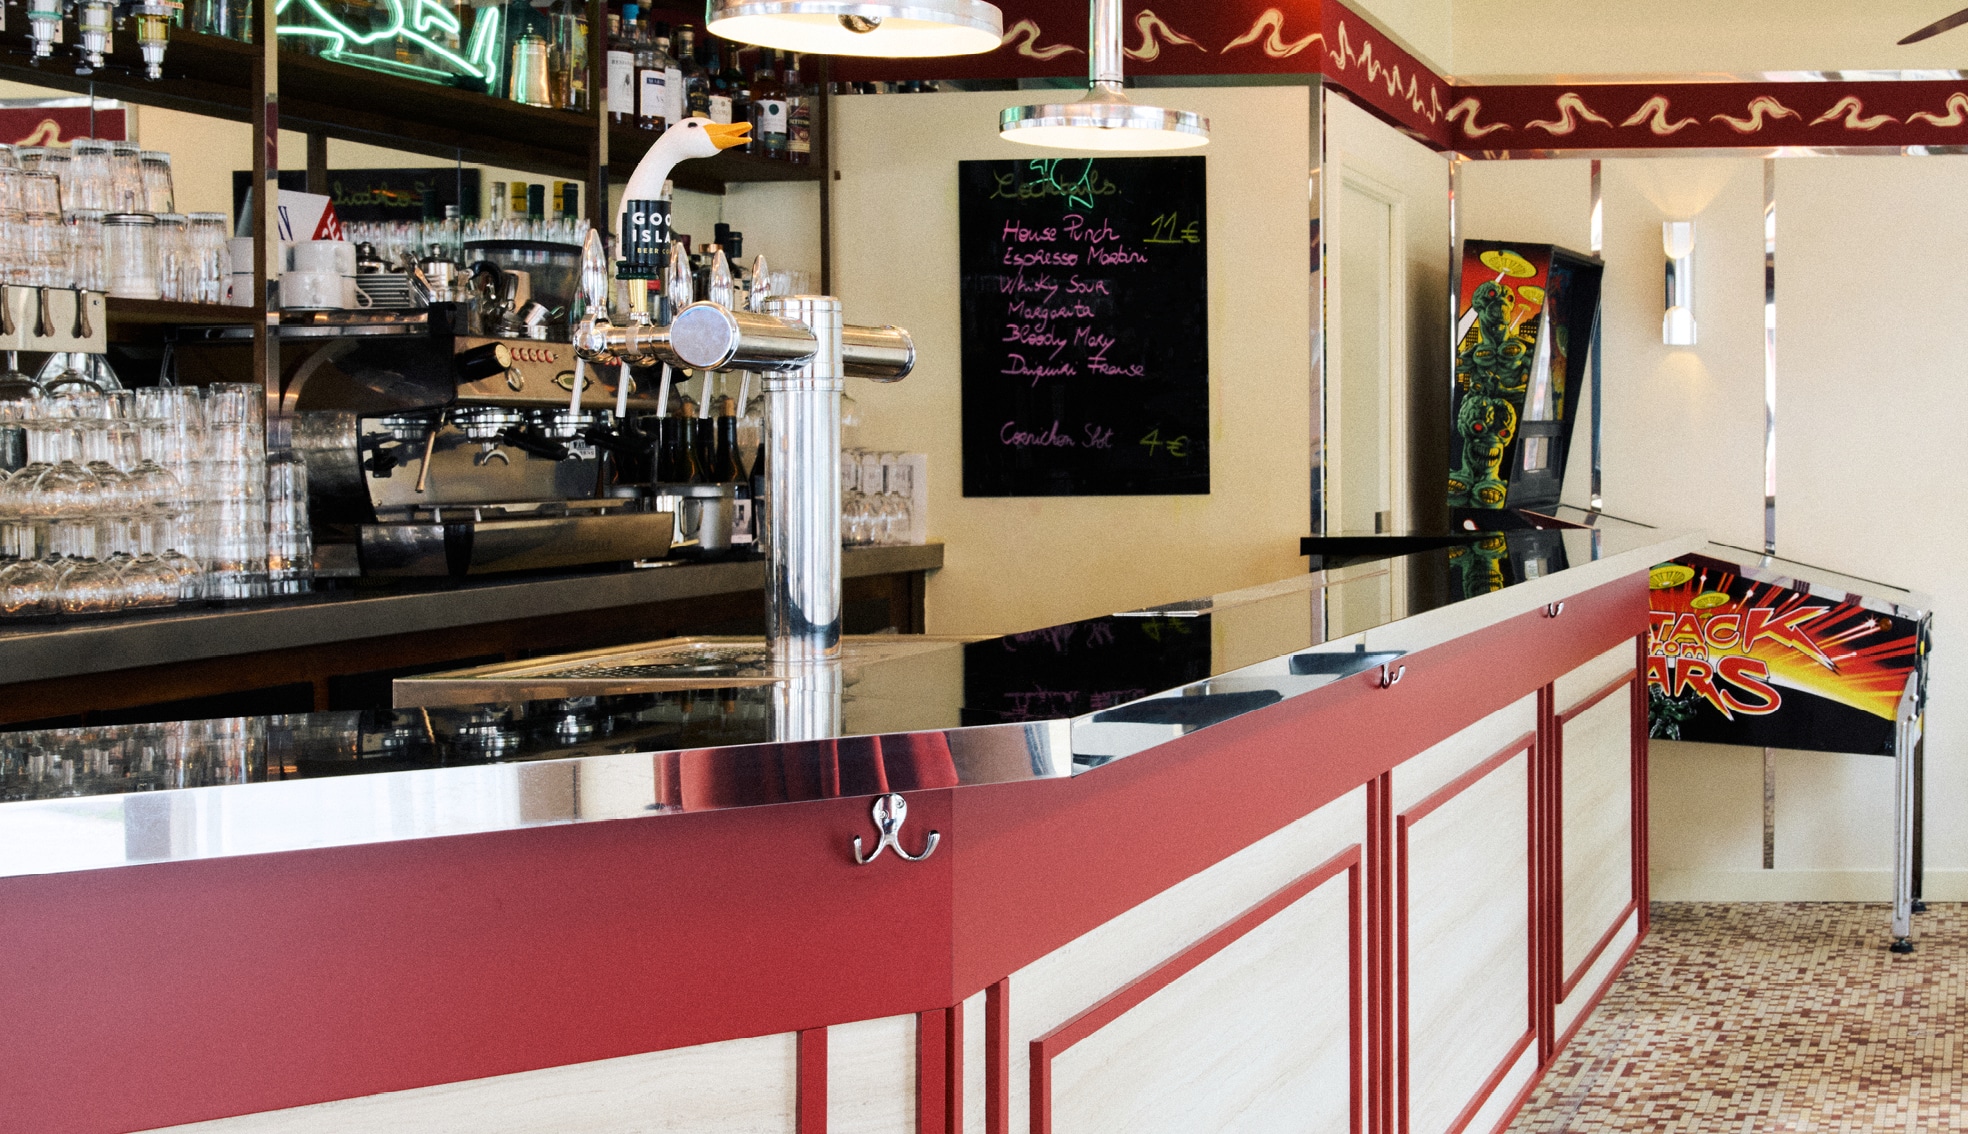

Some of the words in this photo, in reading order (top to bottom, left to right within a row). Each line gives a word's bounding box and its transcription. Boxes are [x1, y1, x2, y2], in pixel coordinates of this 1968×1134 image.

[632, 212, 671, 226] GOO
[1002, 218, 1057, 243] House
[1063, 214, 1120, 243] Punch
[632, 229, 671, 243] ISLA
[1003, 247, 1079, 275] Espresso
[1087, 244, 1148, 265] Martini
[1008, 299, 1095, 332] Margarita
[1002, 323, 1067, 360] Bloody
[1074, 326, 1116, 358] Mary
[1648, 606, 1841, 676] TACK
[1648, 634, 1708, 661] rom
[1648, 655, 1782, 721] ARS
